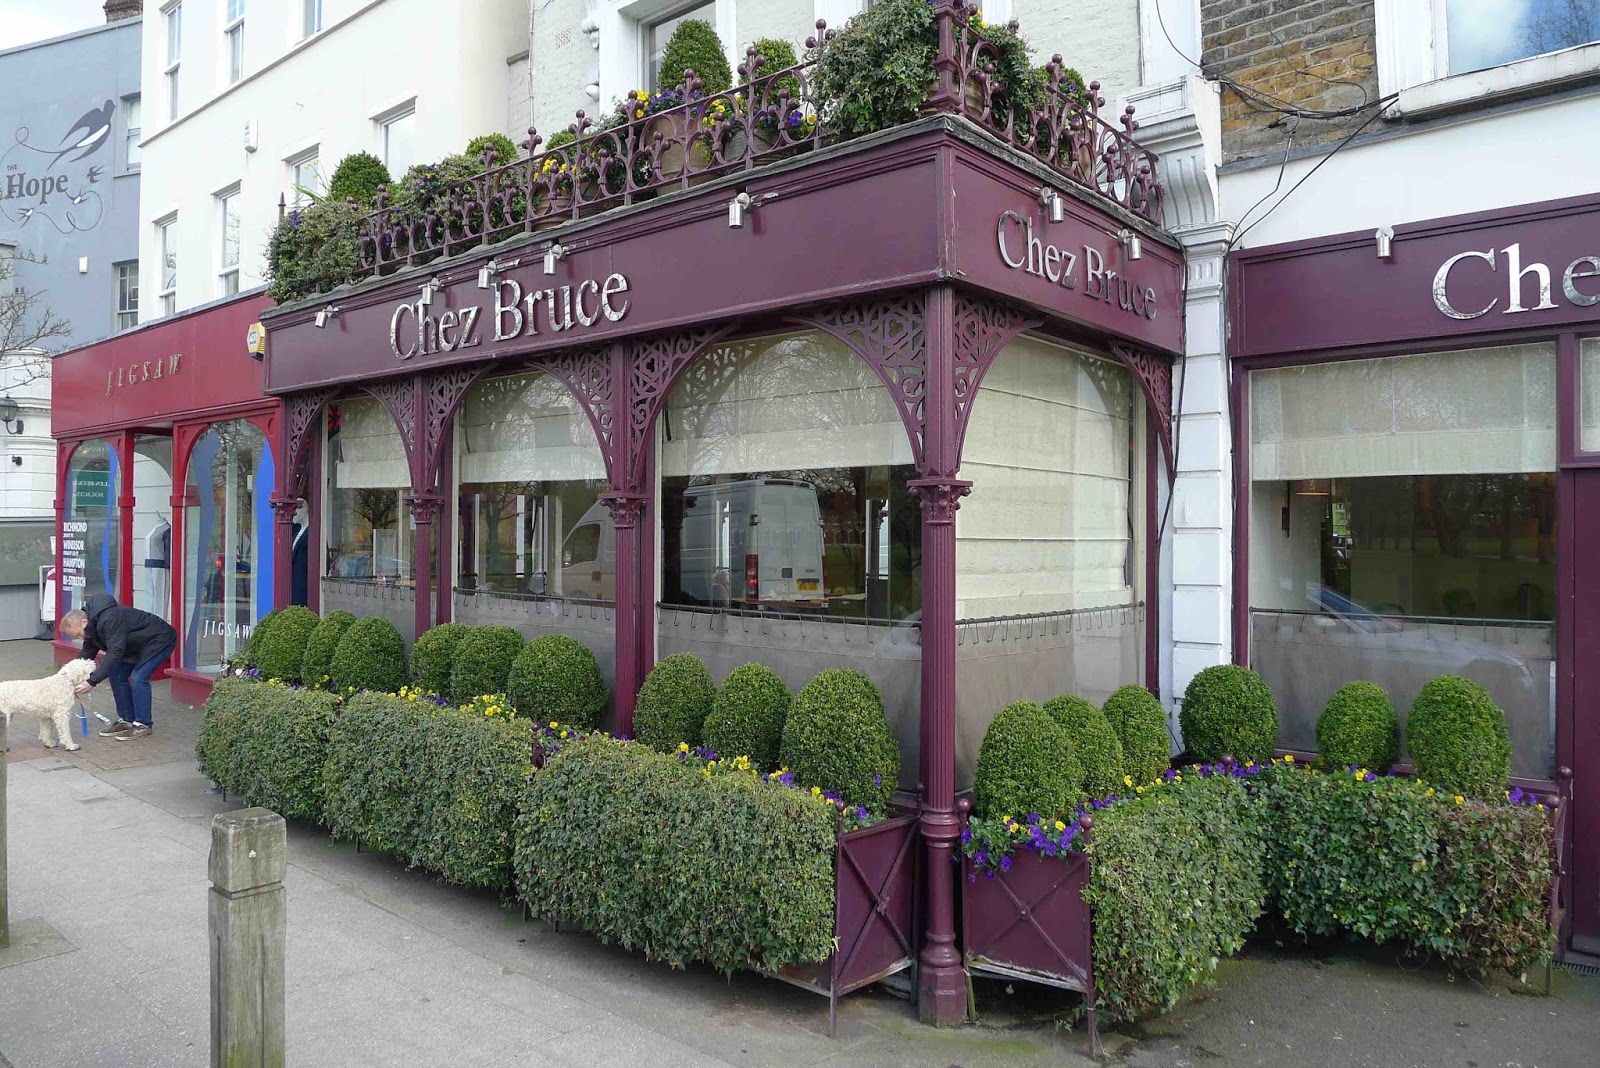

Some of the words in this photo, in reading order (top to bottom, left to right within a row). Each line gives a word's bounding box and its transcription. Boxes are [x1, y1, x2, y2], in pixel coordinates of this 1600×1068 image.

[5, 172, 69, 205] Hope
[998, 210, 1077, 290] Chez
[1084, 244, 1157, 320] Bruce
[1432, 242, 1600, 320] Che
[389, 298, 481, 360] Chez
[491, 273, 631, 342] Bruce
[105, 353, 183, 397] JIGSAW
[63, 540, 84, 551] WINDSOR
[63, 558, 85, 569] HAMPTON
[203, 620, 251, 640] JIGSAW
